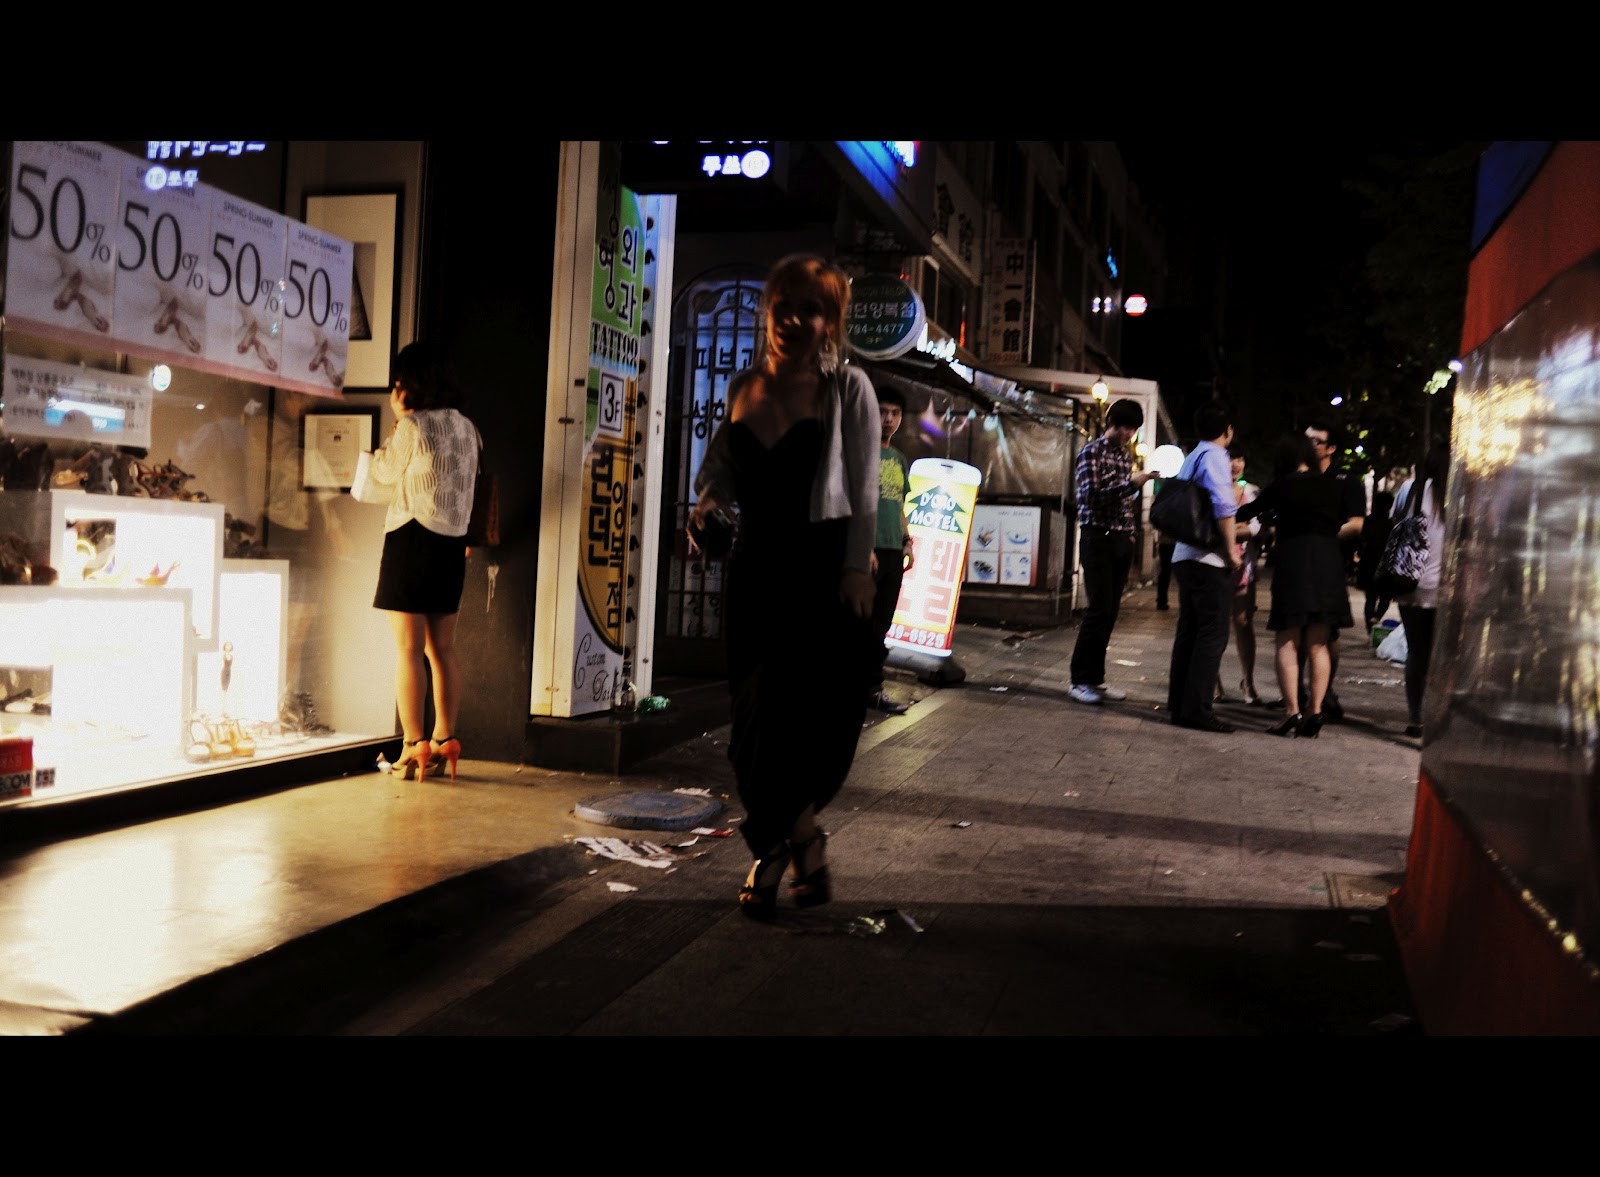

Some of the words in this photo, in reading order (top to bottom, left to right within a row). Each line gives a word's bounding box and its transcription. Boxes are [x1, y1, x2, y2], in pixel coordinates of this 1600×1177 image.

[11, 163, 111, 264] 50%
[118, 200, 204, 291] 50%
[208, 232, 279, 314] 50%
[283, 260, 348, 333] 50%
[592, 321, 638, 368] TATTOO
[604, 382, 620, 424] 3F
[910, 509, 959, 532] MOTEL
